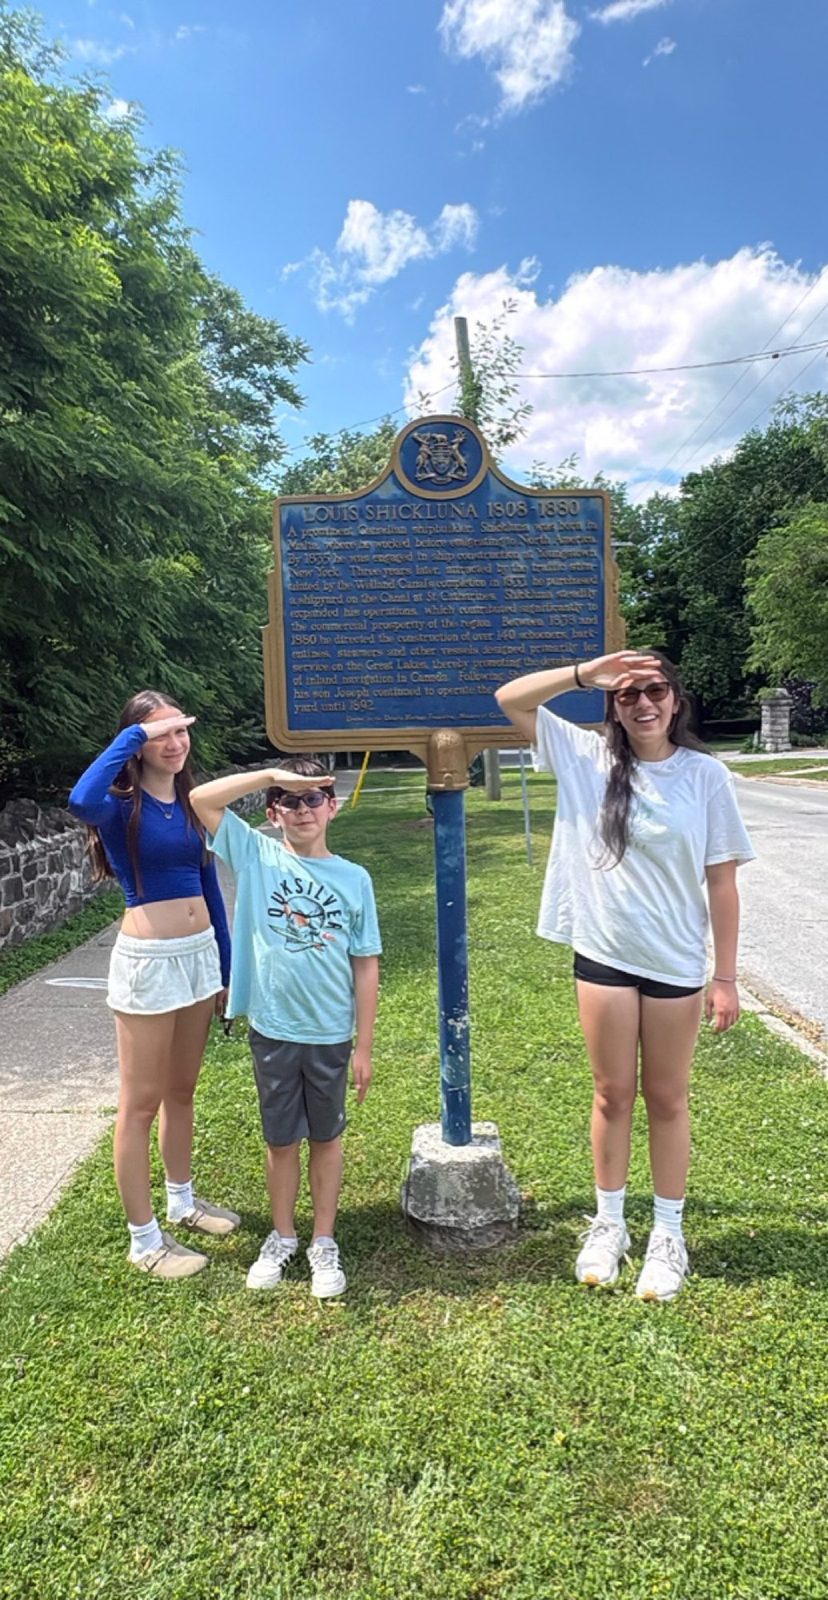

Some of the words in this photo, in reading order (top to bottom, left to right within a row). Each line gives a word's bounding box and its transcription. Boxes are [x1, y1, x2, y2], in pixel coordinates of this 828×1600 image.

[303, 505, 360, 523] LOUIS
[365, 502, 479, 521] SHICKLUNA
[287, 525, 298, 538] A
[302, 527, 353, 540] prominent
[358, 523, 408, 536] Canadian
[373, 538, 411, 549] worked
[518, 533, 550, 545] North
[288, 552, 301, 566] By
[373, 552, 413, 564] engaged
[288, 566, 313, 578] New
[353, 577, 396, 590] Welland
[379, 591, 411, 603] Canal
[290, 606, 339, 620] expanded
[424, 603, 455, 615] which
[310, 619, 367, 631] commercial
[501, 615, 545, 627] Between
[578, 613, 598, 625] and
[334, 633, 375, 644] directed
[397, 631, 459, 643] construction
[472, 631, 495, 641] over
[410, 645, 438, 656] other
[292, 662, 329, 672] service
[366, 659, 394, 671] Great
[341, 673, 395, 686] navigation
[294, 687, 310, 699] his
[312, 690, 331, 698] son
[334, 686, 370, 699] Joseph
[372, 686, 422, 697] continued
[294, 702, 318, 714] yard
[321, 700, 346, 711] until
[267, 877, 343, 931] QUKSILVER
